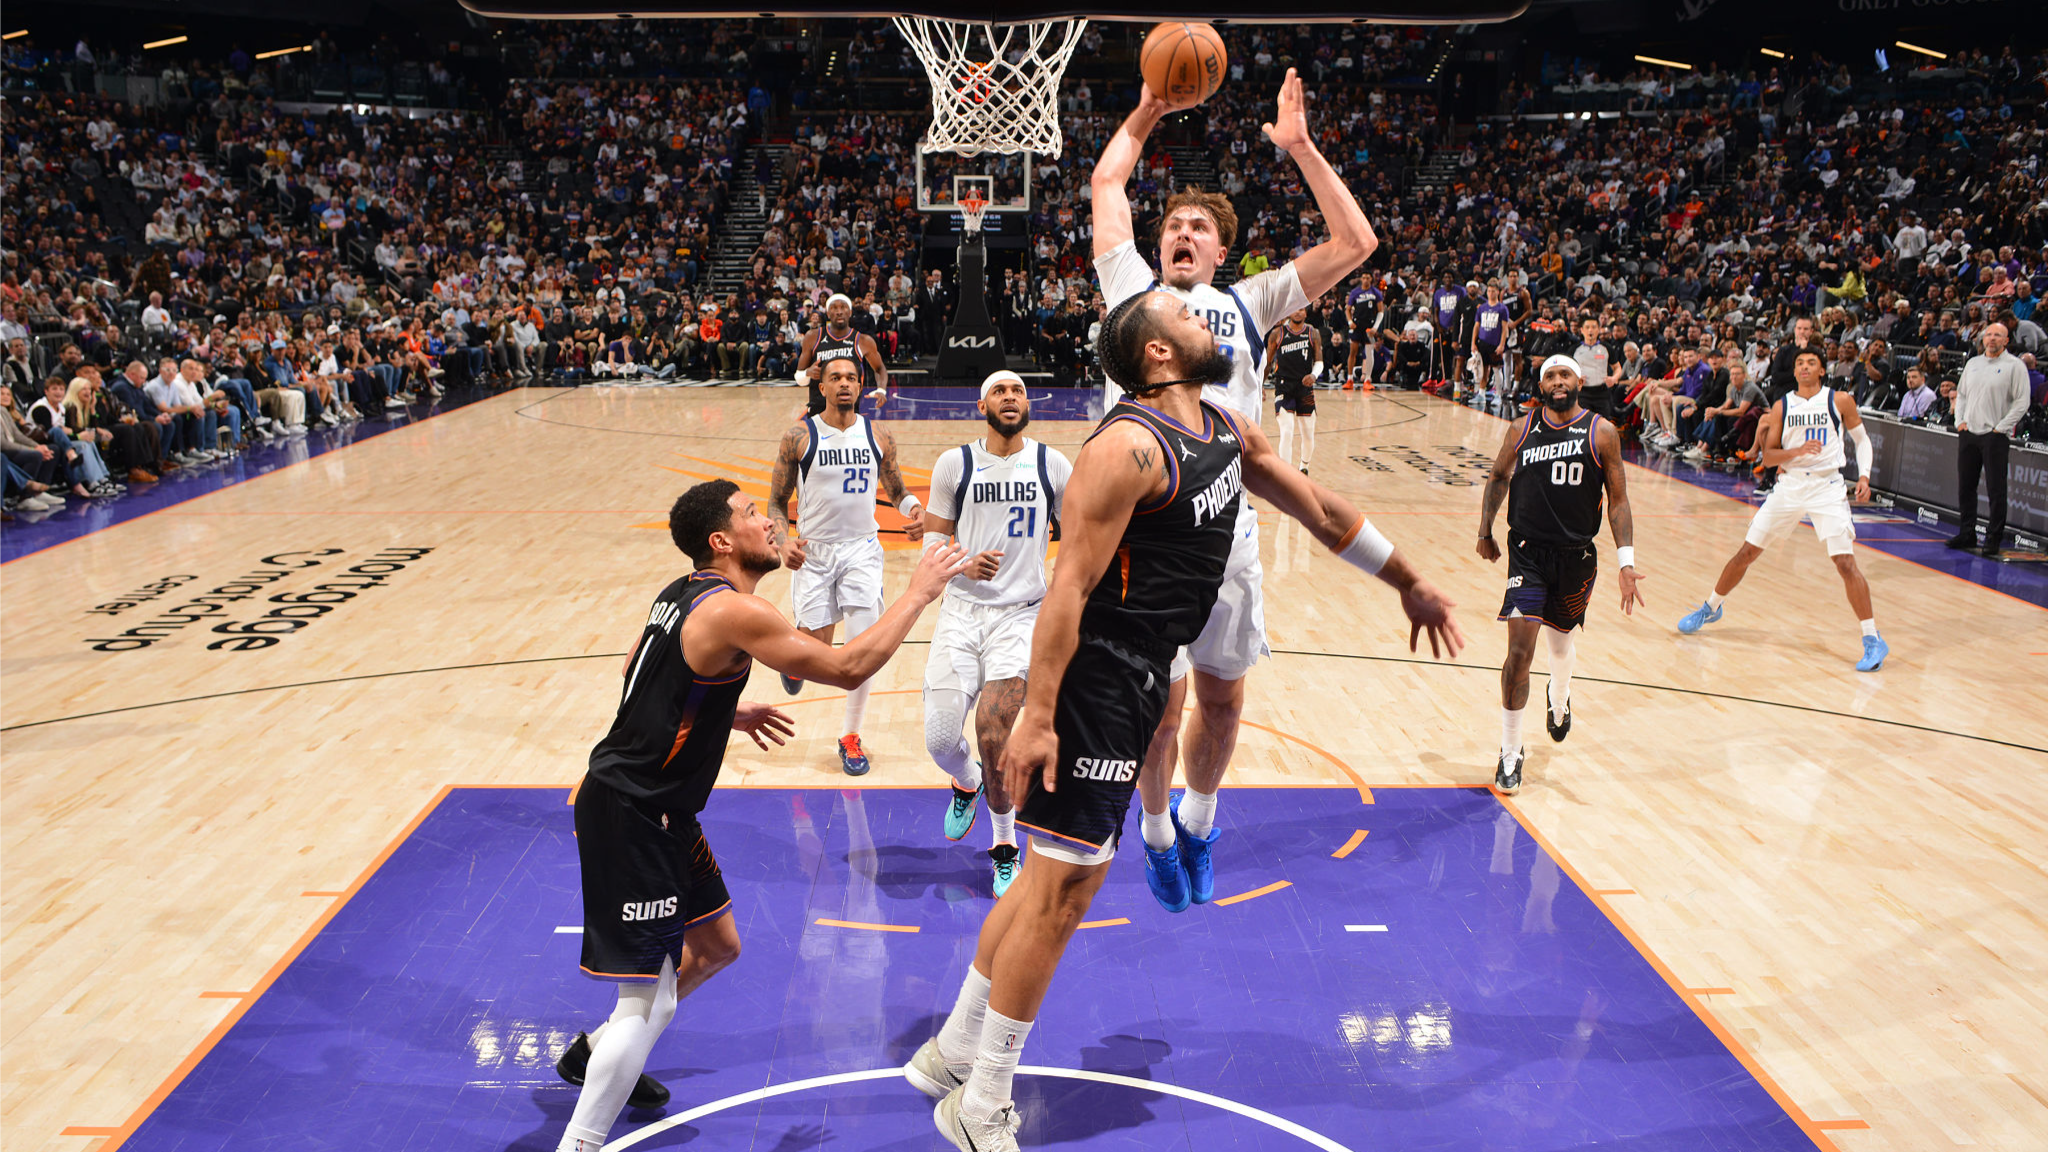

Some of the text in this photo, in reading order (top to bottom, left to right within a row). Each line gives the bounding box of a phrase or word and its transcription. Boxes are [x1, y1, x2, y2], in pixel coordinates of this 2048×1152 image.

[949, 336, 995, 348] KIA
[1281, 340, 1309, 354] PHOENIX
[1302, 349, 1308, 360] 4
[1788, 413, 1828, 427] DALLAS
[819, 448, 870, 467] DALLAS
[1523, 439, 1584, 466] PHOENIX
[843, 468, 870, 493] 25
[1551, 461, 1584, 485] 00
[973, 482, 1037, 503] DALLAS
[1008, 507, 1036, 538] 21
[86, 574, 199, 616] center
[206, 547, 436, 651] mortgage
[83, 570, 295, 651] matchup
[623, 633, 655, 704] 1
[1073, 757, 1137, 782] SUNS
[622, 896, 678, 921] SUNS
